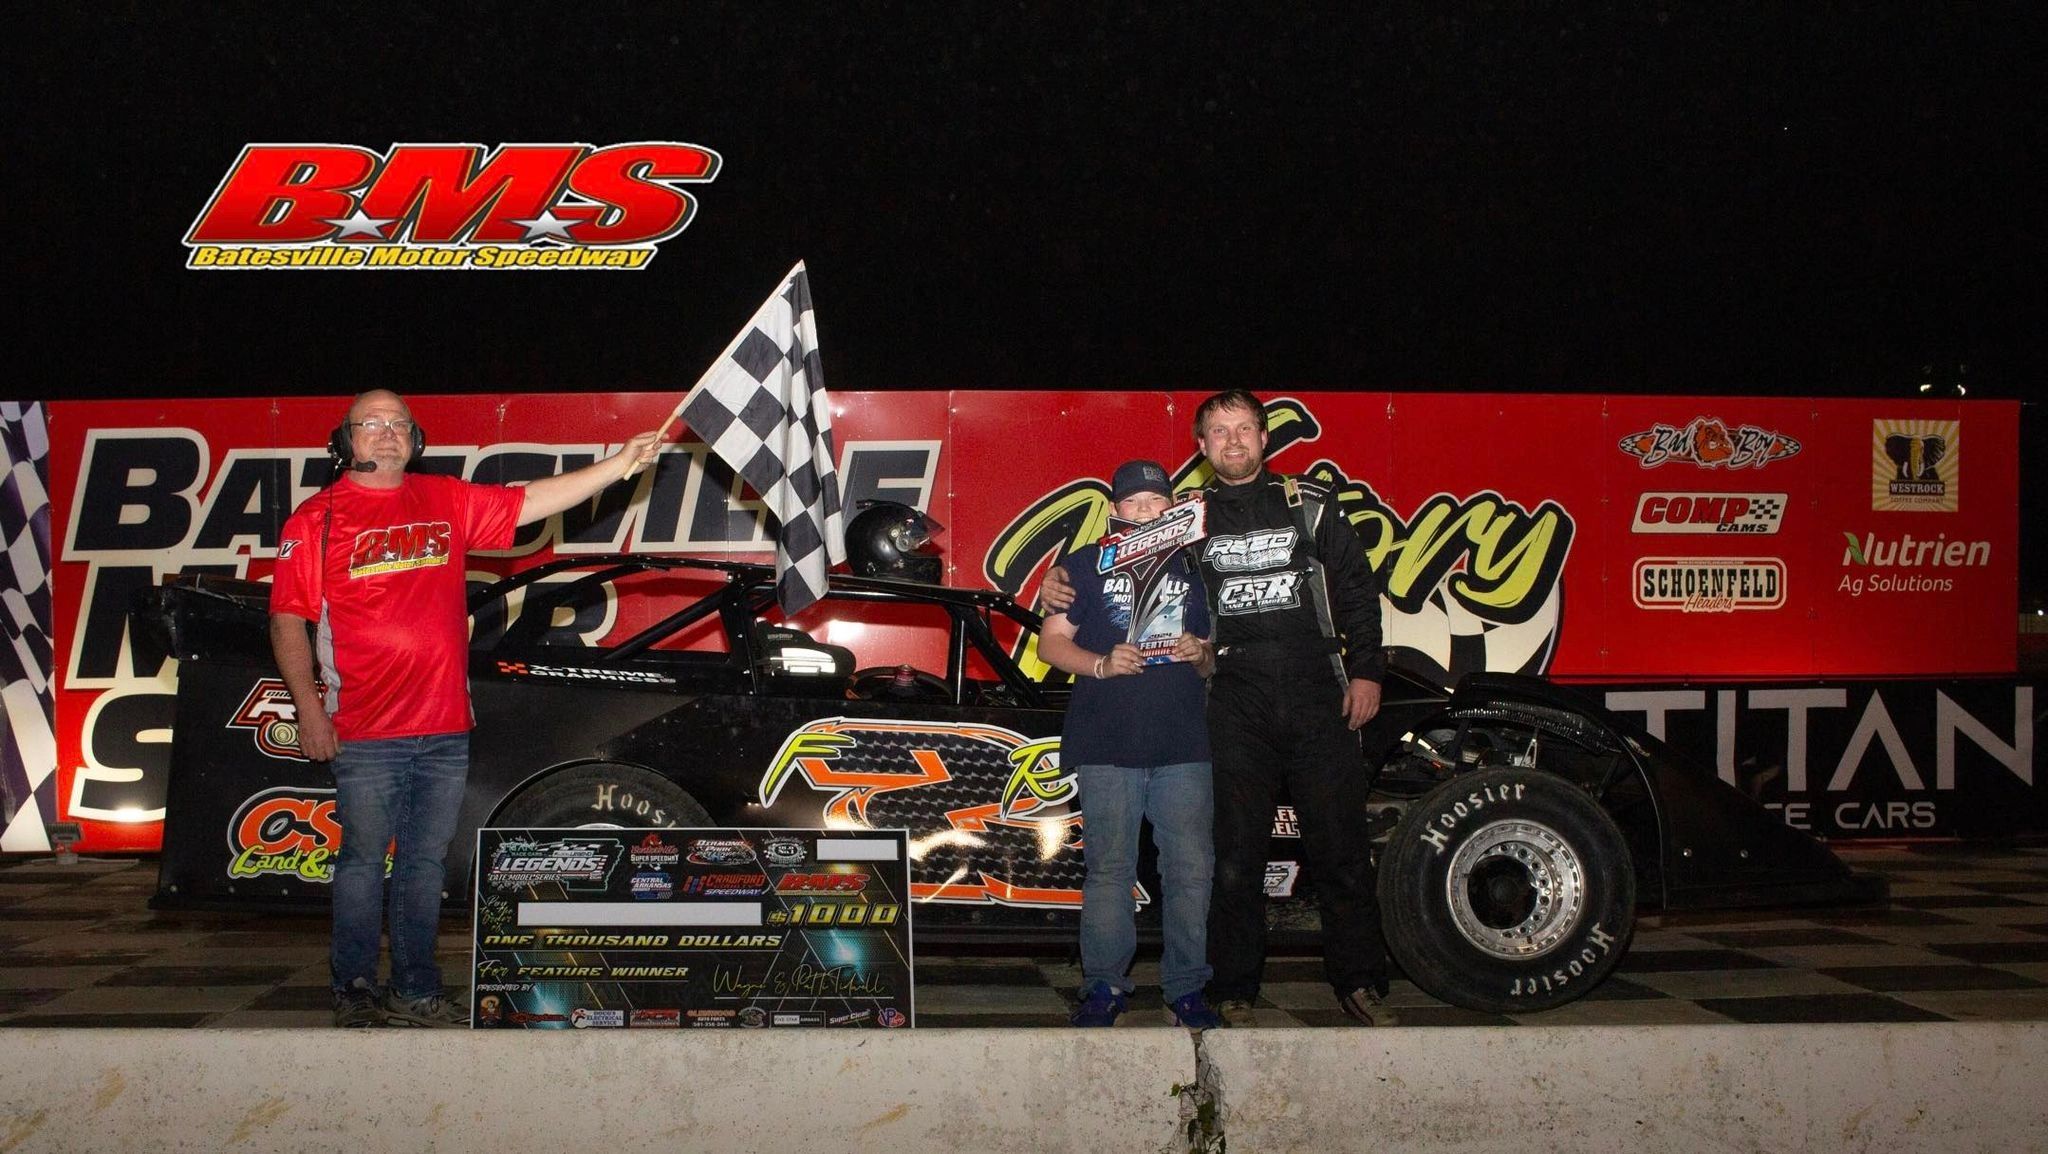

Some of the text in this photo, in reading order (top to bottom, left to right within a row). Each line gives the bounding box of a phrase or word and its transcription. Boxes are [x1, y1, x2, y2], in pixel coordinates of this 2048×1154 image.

[1643, 427, 1777, 466] Bad Boy
[1890, 483, 1944, 494] WESTROCK
[1640, 496, 1750, 524] COMP
[1120, 519, 1190, 559] LEGENDS
[1716, 523, 1768, 533] CAMS
[350, 522, 451, 570] BMS
[1208, 531, 1294, 557] REED
[1842, 531, 1991, 567] Nutrien
[1103, 578, 1190, 594] BATLLE
[1221, 573, 1297, 604] CSR
[1643, 568, 1777, 598] SCHOENFELD
[1838, 574, 1953, 596] Ag Solutions
[1113, 594, 1132, 604] MOT
[1684, 591, 1734, 610] Headers
[1139, 639, 1178, 650] FEATUR
[529, 664, 664, 678] X-TREME
[529, 670, 660, 684] GRAPHICS
[1605, 686, 2034, 791] TITAN
[1420, 782, 1527, 855] Hoosier
[1835, 801, 1937, 830] CARS
[232, 844, 300, 875] Land
[499, 857, 599, 871] LEGENDS
[533, 873, 561, 881] SERIES
[706, 873, 768, 887] CRAWFORD
[704, 888, 762, 896] SPEEDWAY
[768, 903, 902, 927] $1000
[484, 935, 782, 947] ONE THOUSAND DOLLARS
[1510, 922, 1615, 996] Hoosier
[517, 967, 603, 977] FEATURE
[610, 967, 689, 977] WINNER
